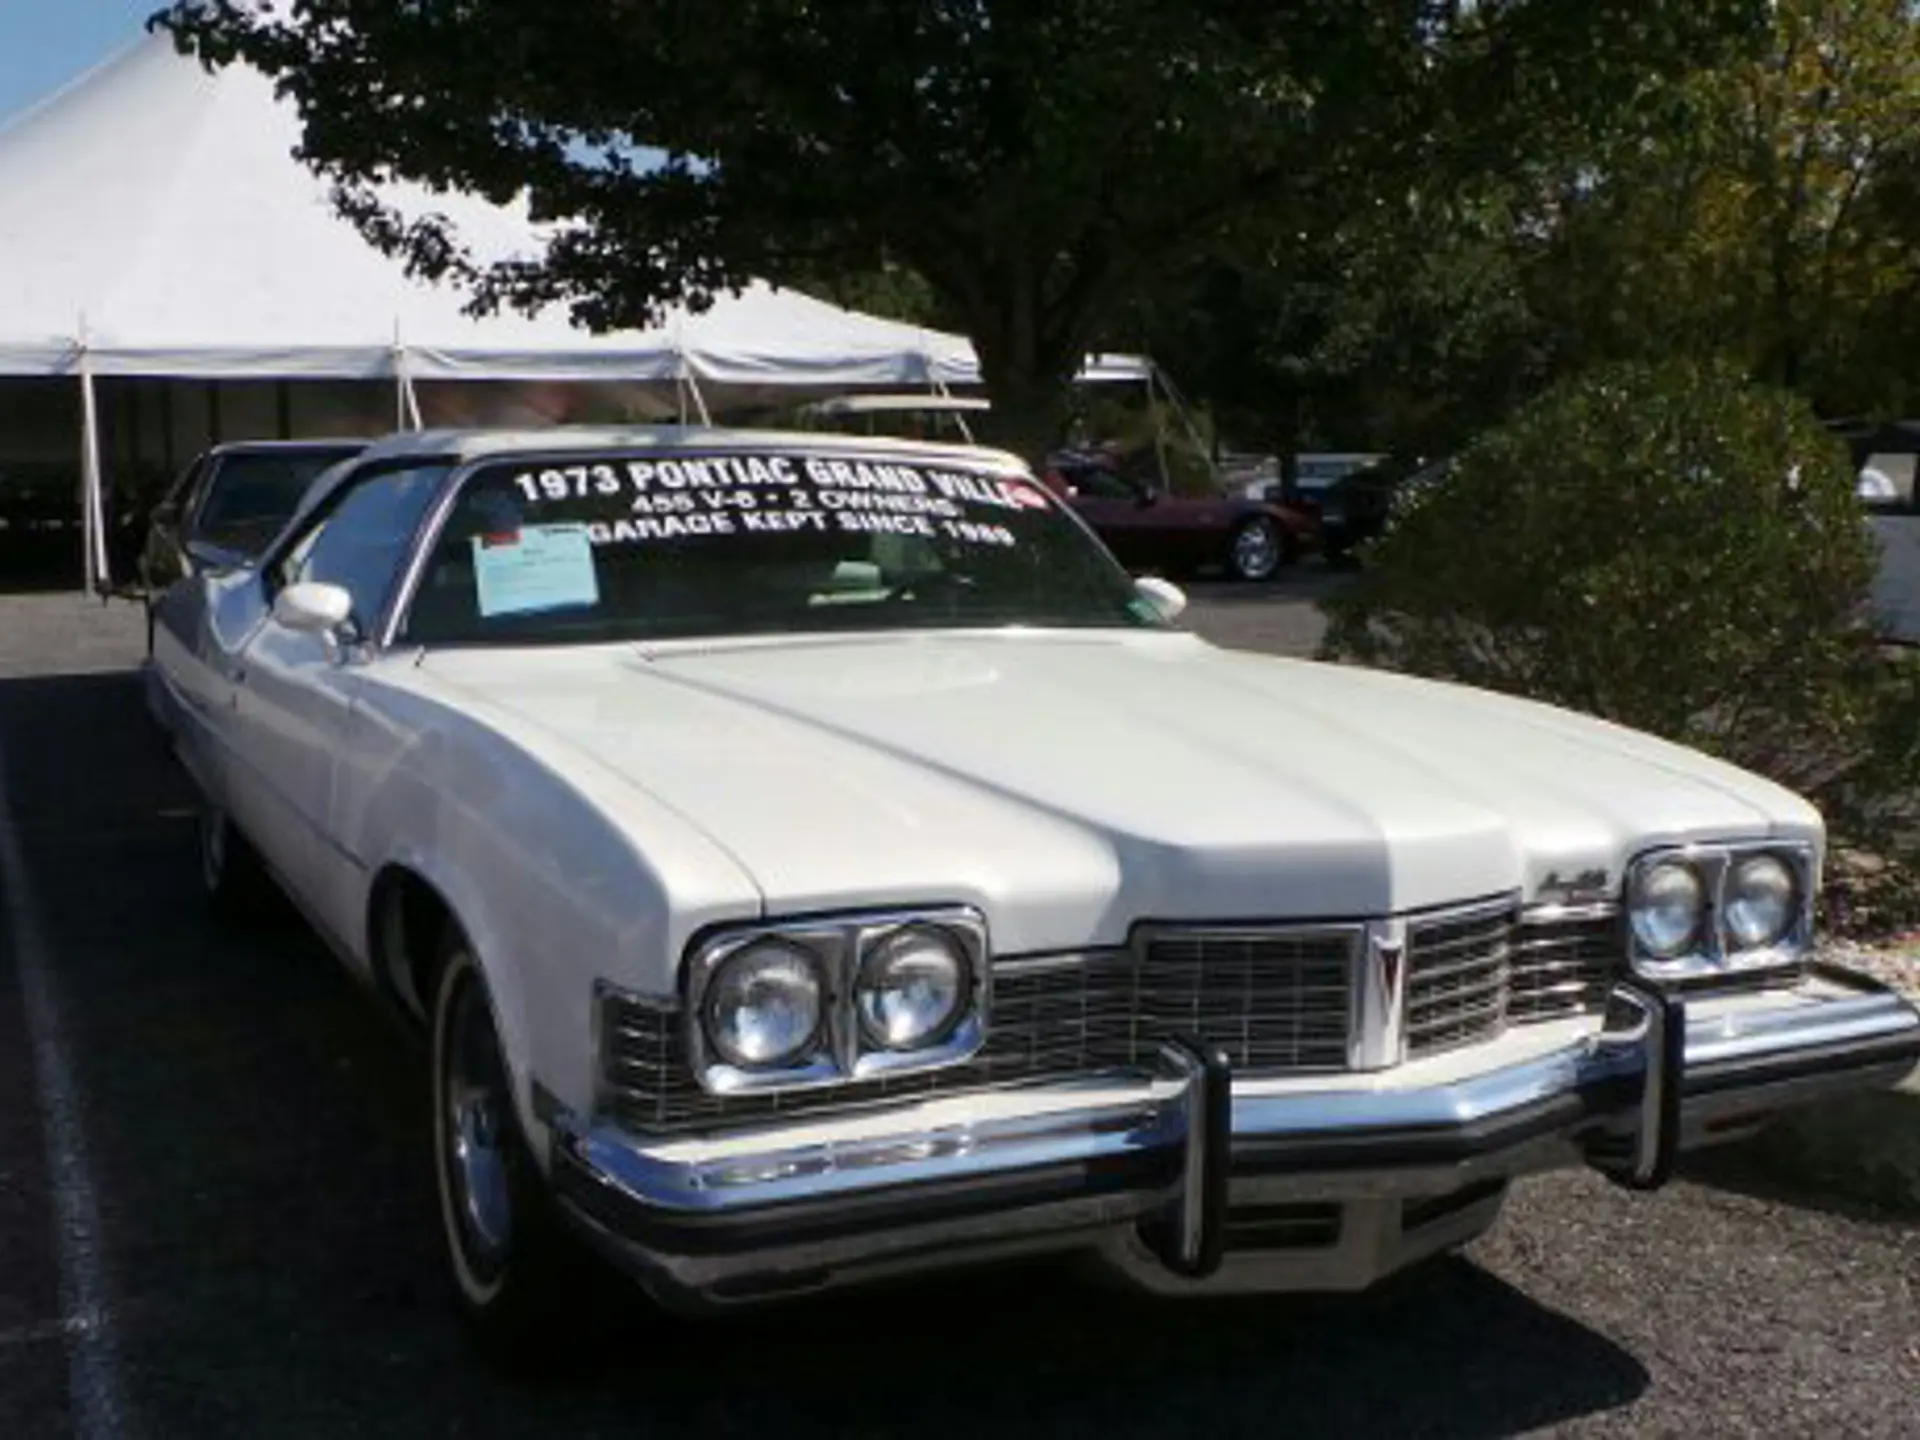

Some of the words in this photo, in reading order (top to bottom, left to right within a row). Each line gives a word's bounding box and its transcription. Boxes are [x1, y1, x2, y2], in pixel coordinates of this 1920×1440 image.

[514, 465, 621, 501] 1973
[626, 457, 799, 491] PONTIAC
[804, 457, 928, 493] GRAND
[788, 488, 813, 508] 2
[588, 511, 737, 545] GARAGE
[740, 510, 827, 531] KEPT
[836, 511, 936, 538] SINCE
